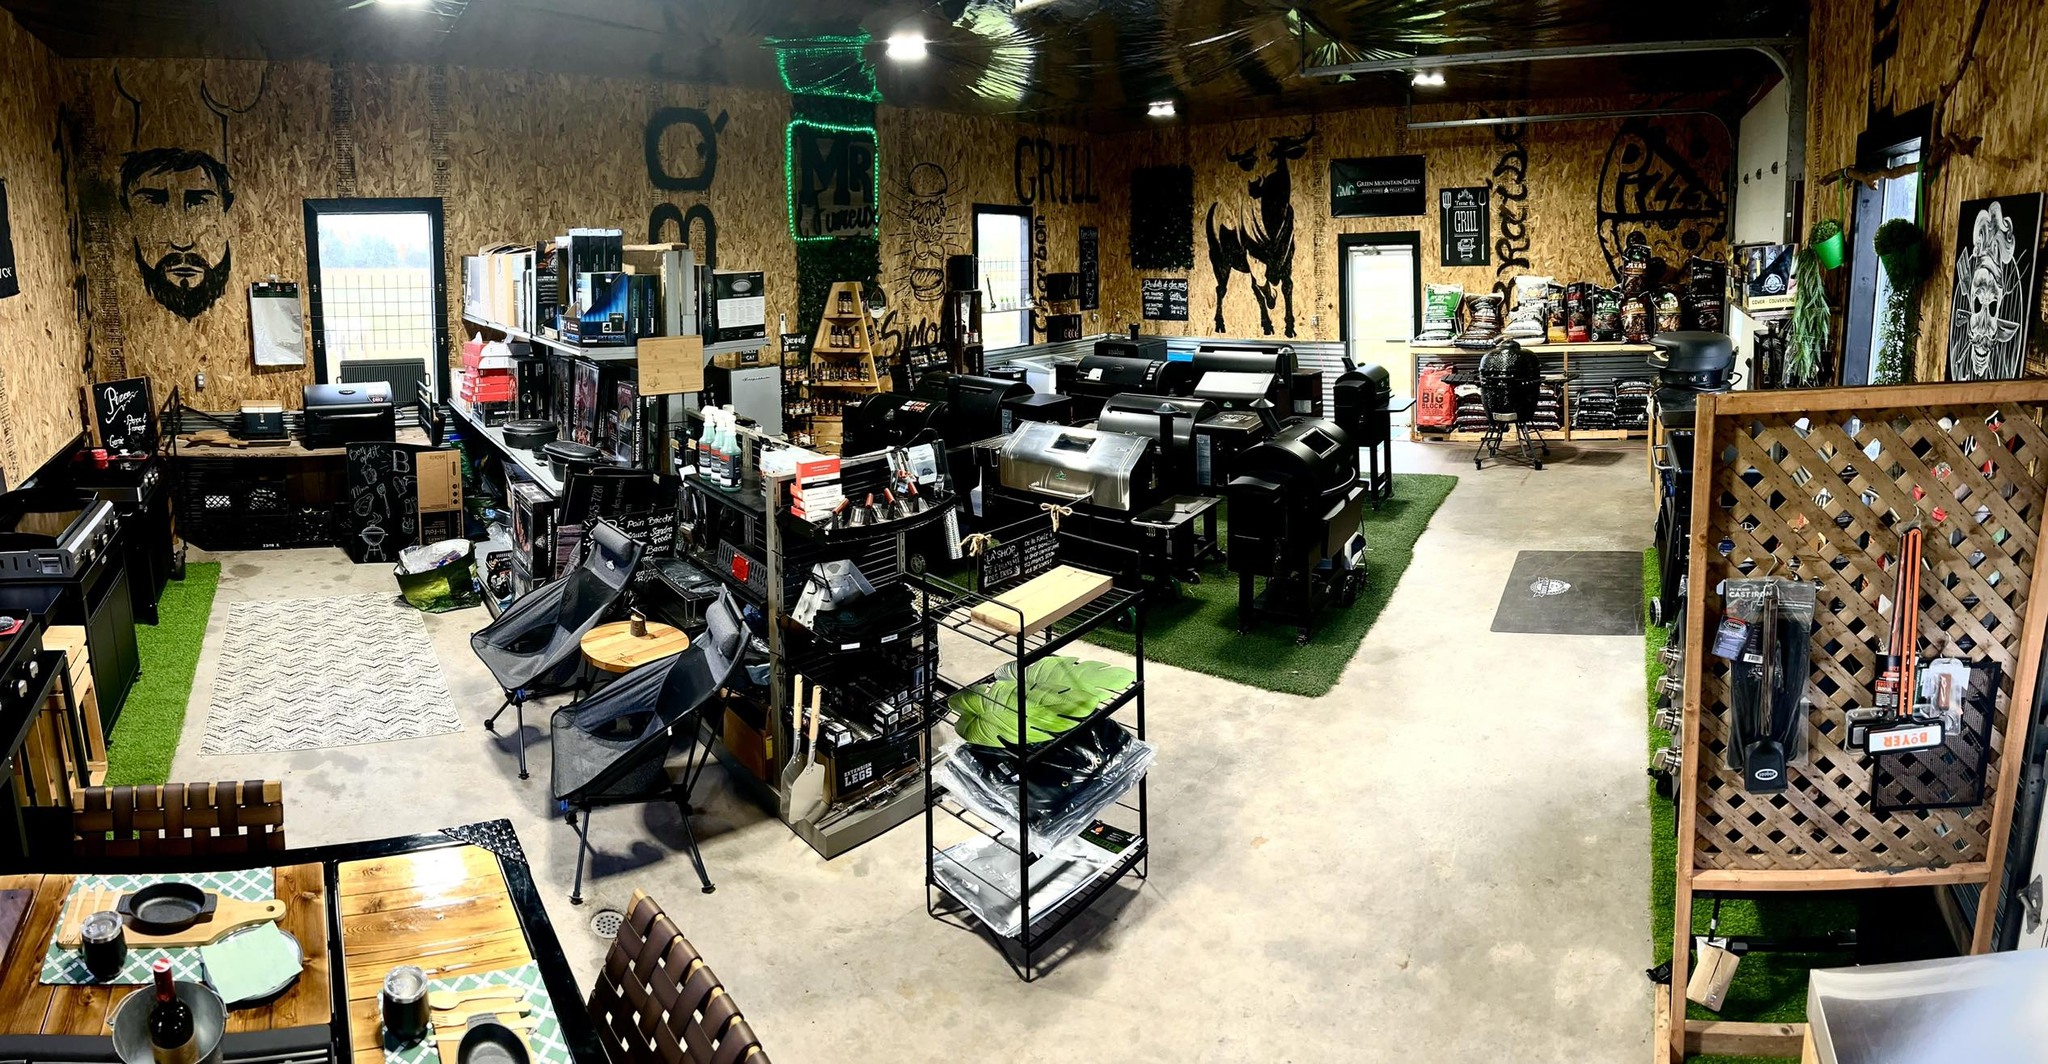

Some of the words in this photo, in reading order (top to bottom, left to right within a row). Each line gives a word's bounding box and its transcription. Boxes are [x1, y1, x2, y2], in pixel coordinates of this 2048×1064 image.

[1014, 135, 1099, 206] GRILL
[1374, 179, 1403, 187] MOUNTAIN
[1454, 210, 1479, 233] GRILL
[1597, 301, 1620, 310] APPLE
[1621, 303, 1644, 312] TEXAS
[1422, 392, 1444, 404] BIG
[627, 519, 645, 529] Pain
[645, 544, 670, 555] Bacon
[1750, 590, 1773, 598] IRON
[1883, 731, 1928, 748] BOYER
[843, 762, 873, 778] EXTENSION
[844, 767, 873, 787] LEGS
